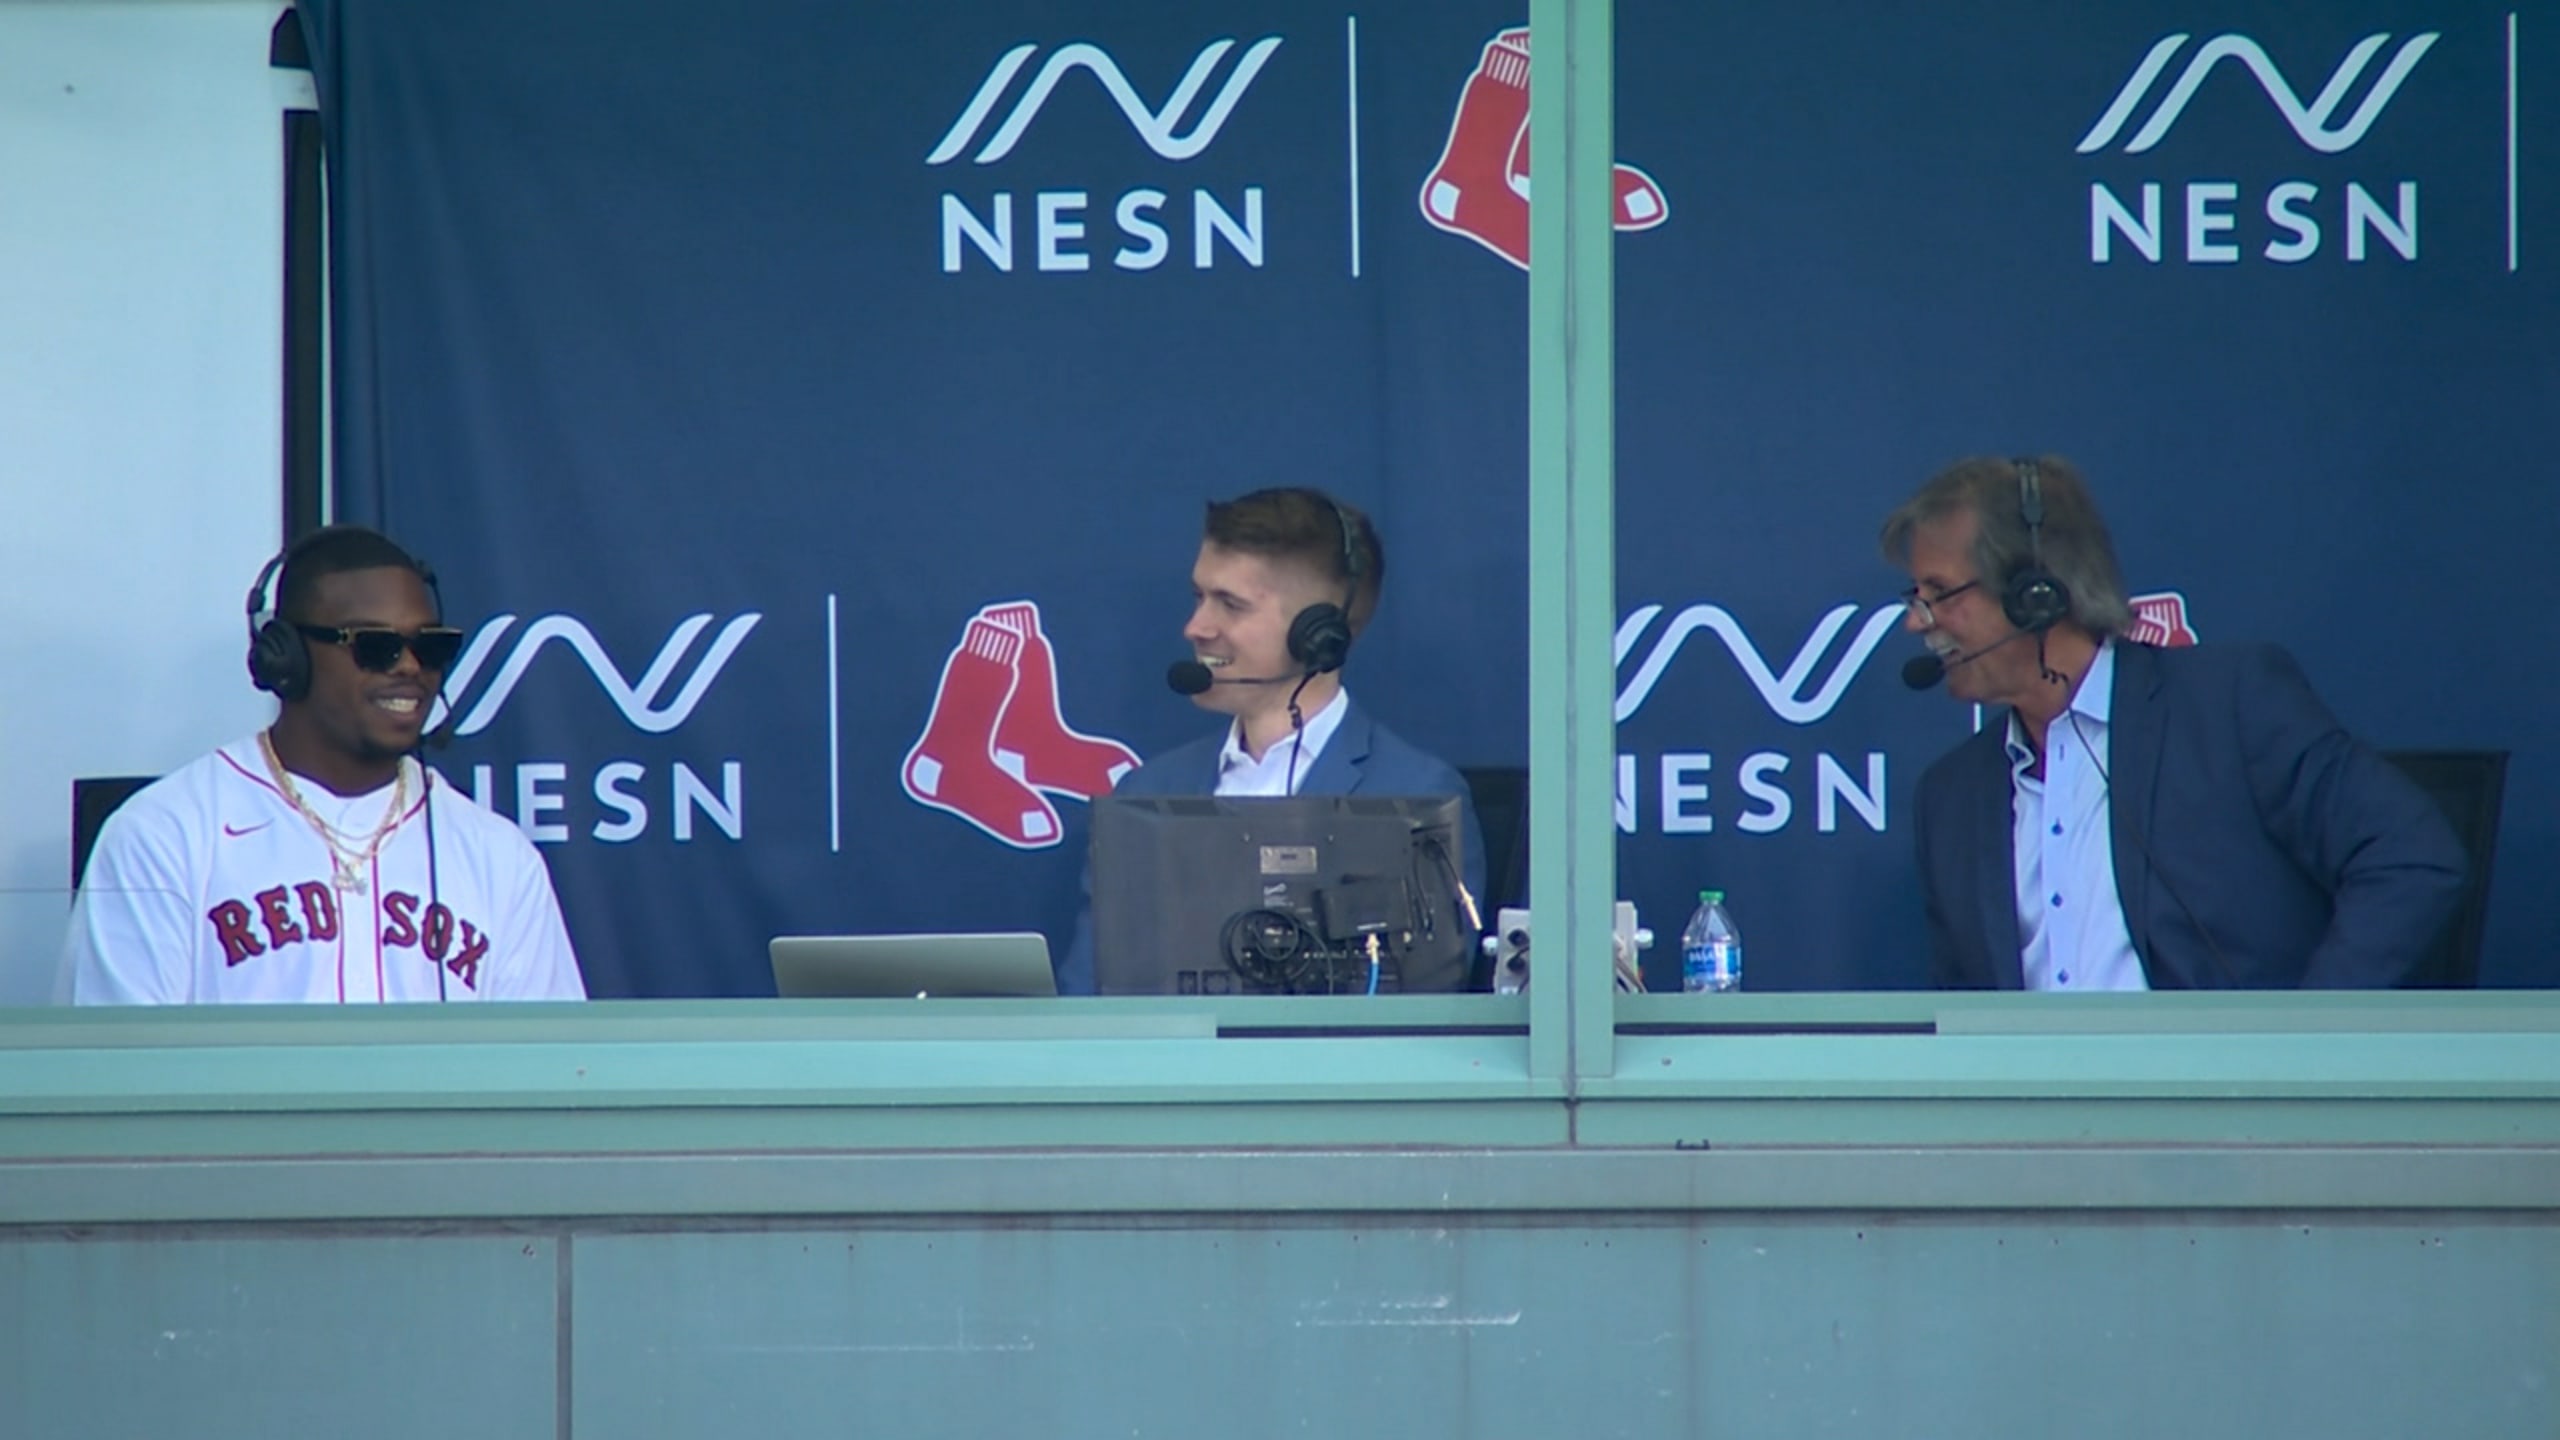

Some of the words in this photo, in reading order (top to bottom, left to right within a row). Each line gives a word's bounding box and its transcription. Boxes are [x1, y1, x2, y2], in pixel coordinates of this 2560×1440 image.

[942, 188, 1263, 272] NESN
[2091, 181, 2416, 263] NESN
[474, 761, 742, 842] ESN
[208, 880, 338, 967] RED
[382, 890, 490, 992] SOX
